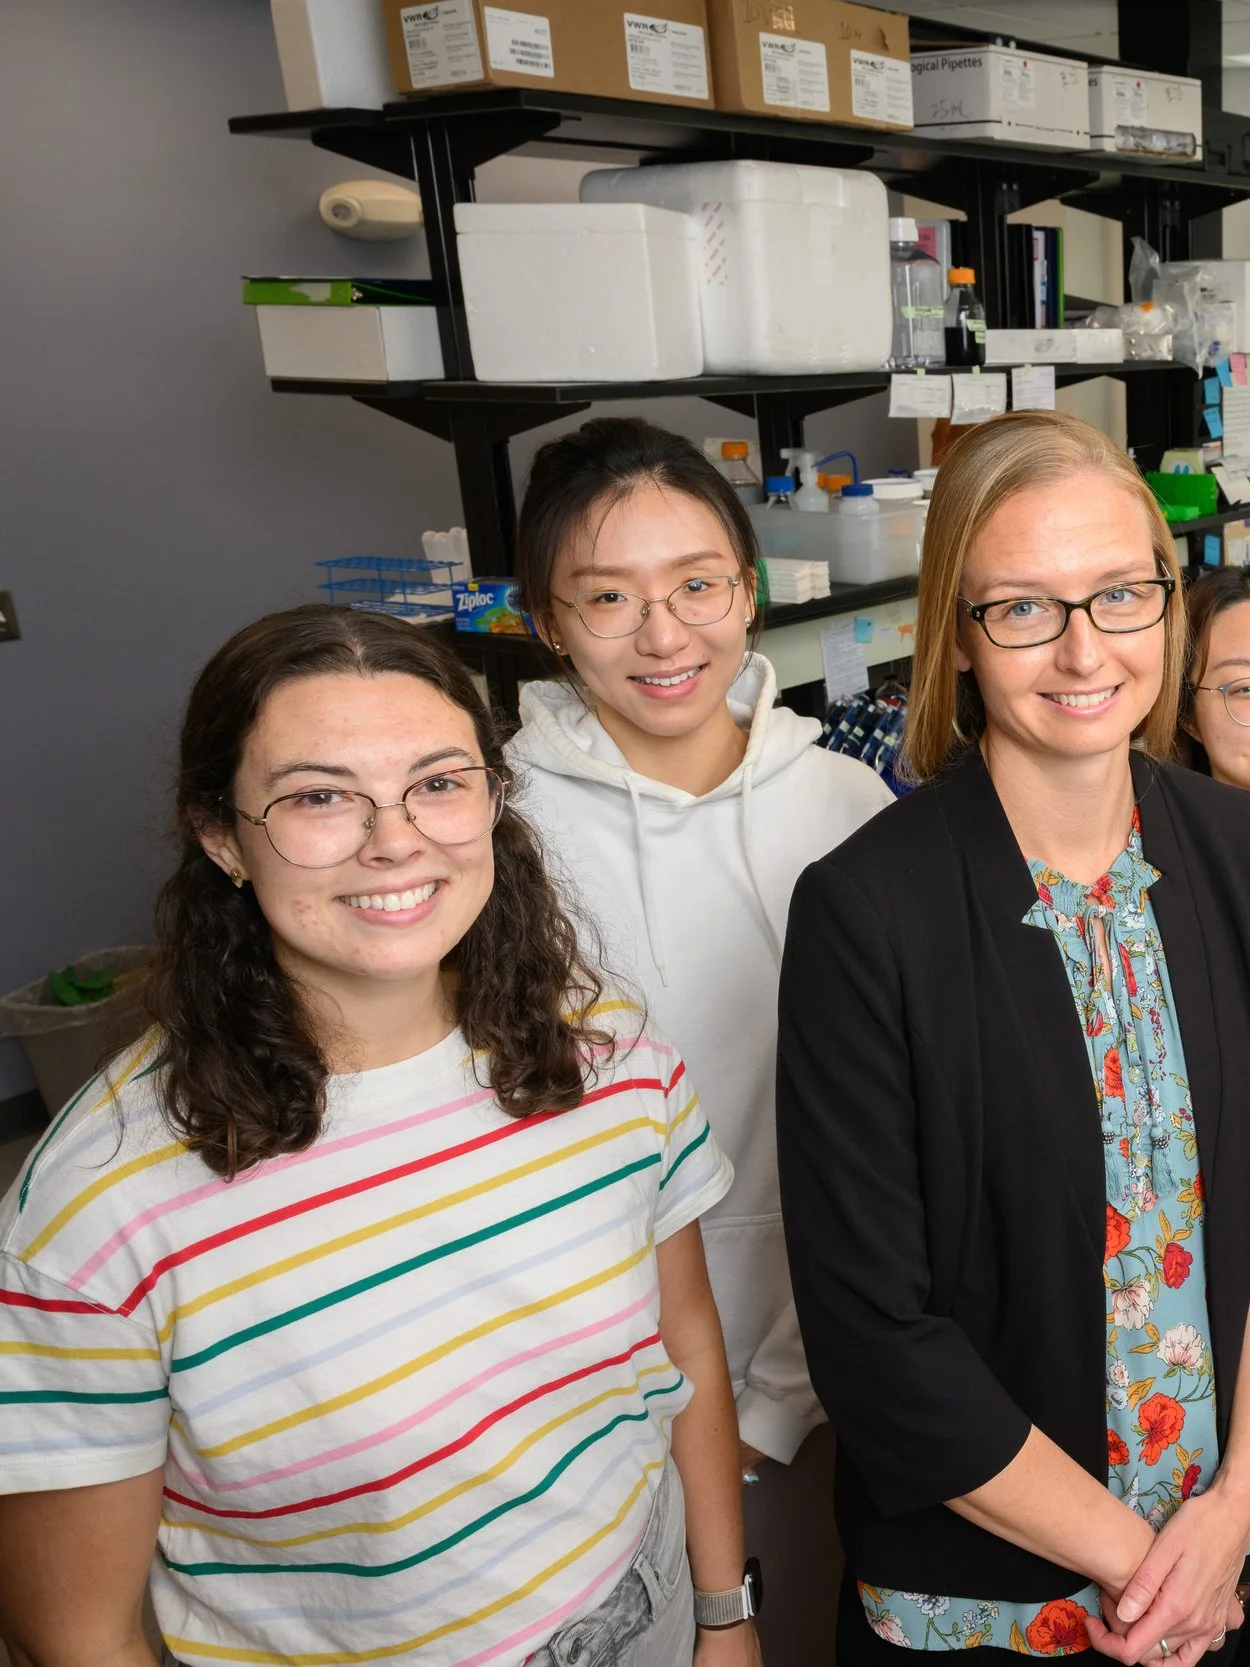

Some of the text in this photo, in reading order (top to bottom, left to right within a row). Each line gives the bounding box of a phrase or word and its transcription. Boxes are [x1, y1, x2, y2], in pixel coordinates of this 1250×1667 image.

[403, 13, 424, 24] VWR
[626, 20, 649, 31] VWR
[762, 41, 781, 50] VWR
[853, 57, 872, 67] VWR
[941, 57, 983, 72] Pipettes
[456, 591, 495, 612] Ziploc
